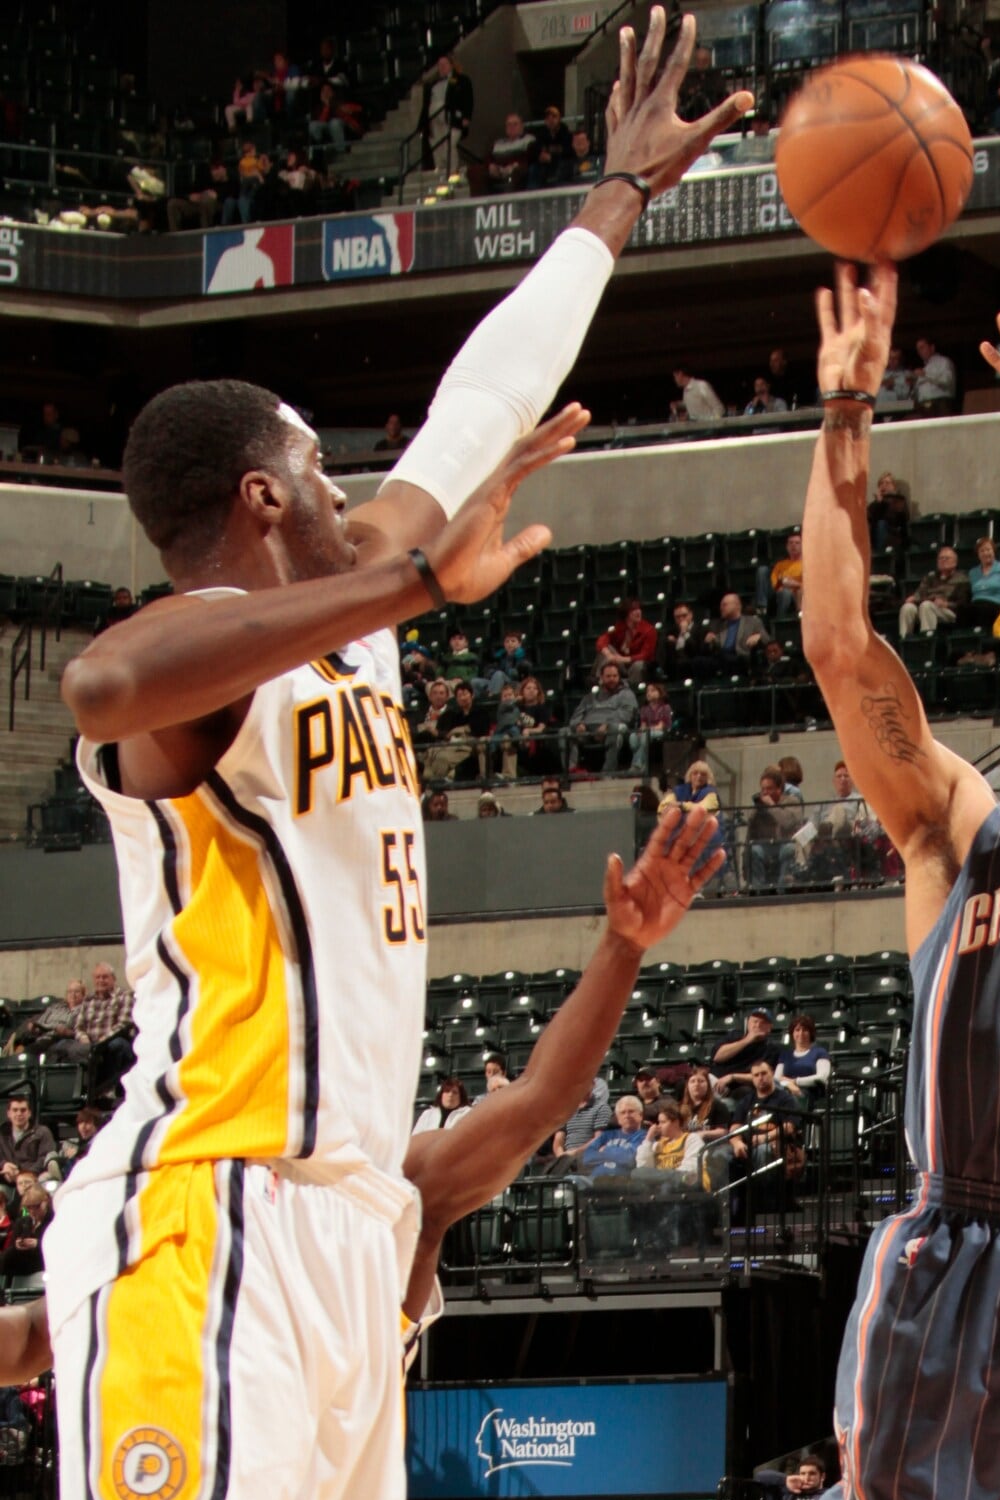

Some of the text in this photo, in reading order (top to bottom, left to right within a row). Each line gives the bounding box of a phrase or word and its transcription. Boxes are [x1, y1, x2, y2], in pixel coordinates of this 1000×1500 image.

[475, 203, 522, 230] MIL
[332, 234, 387, 273] NBA
[474, 231, 536, 260] WSH
[379, 828, 427, 946] 55
[493, 1416, 597, 1441] Washington
[501, 1437, 576, 1459] National
